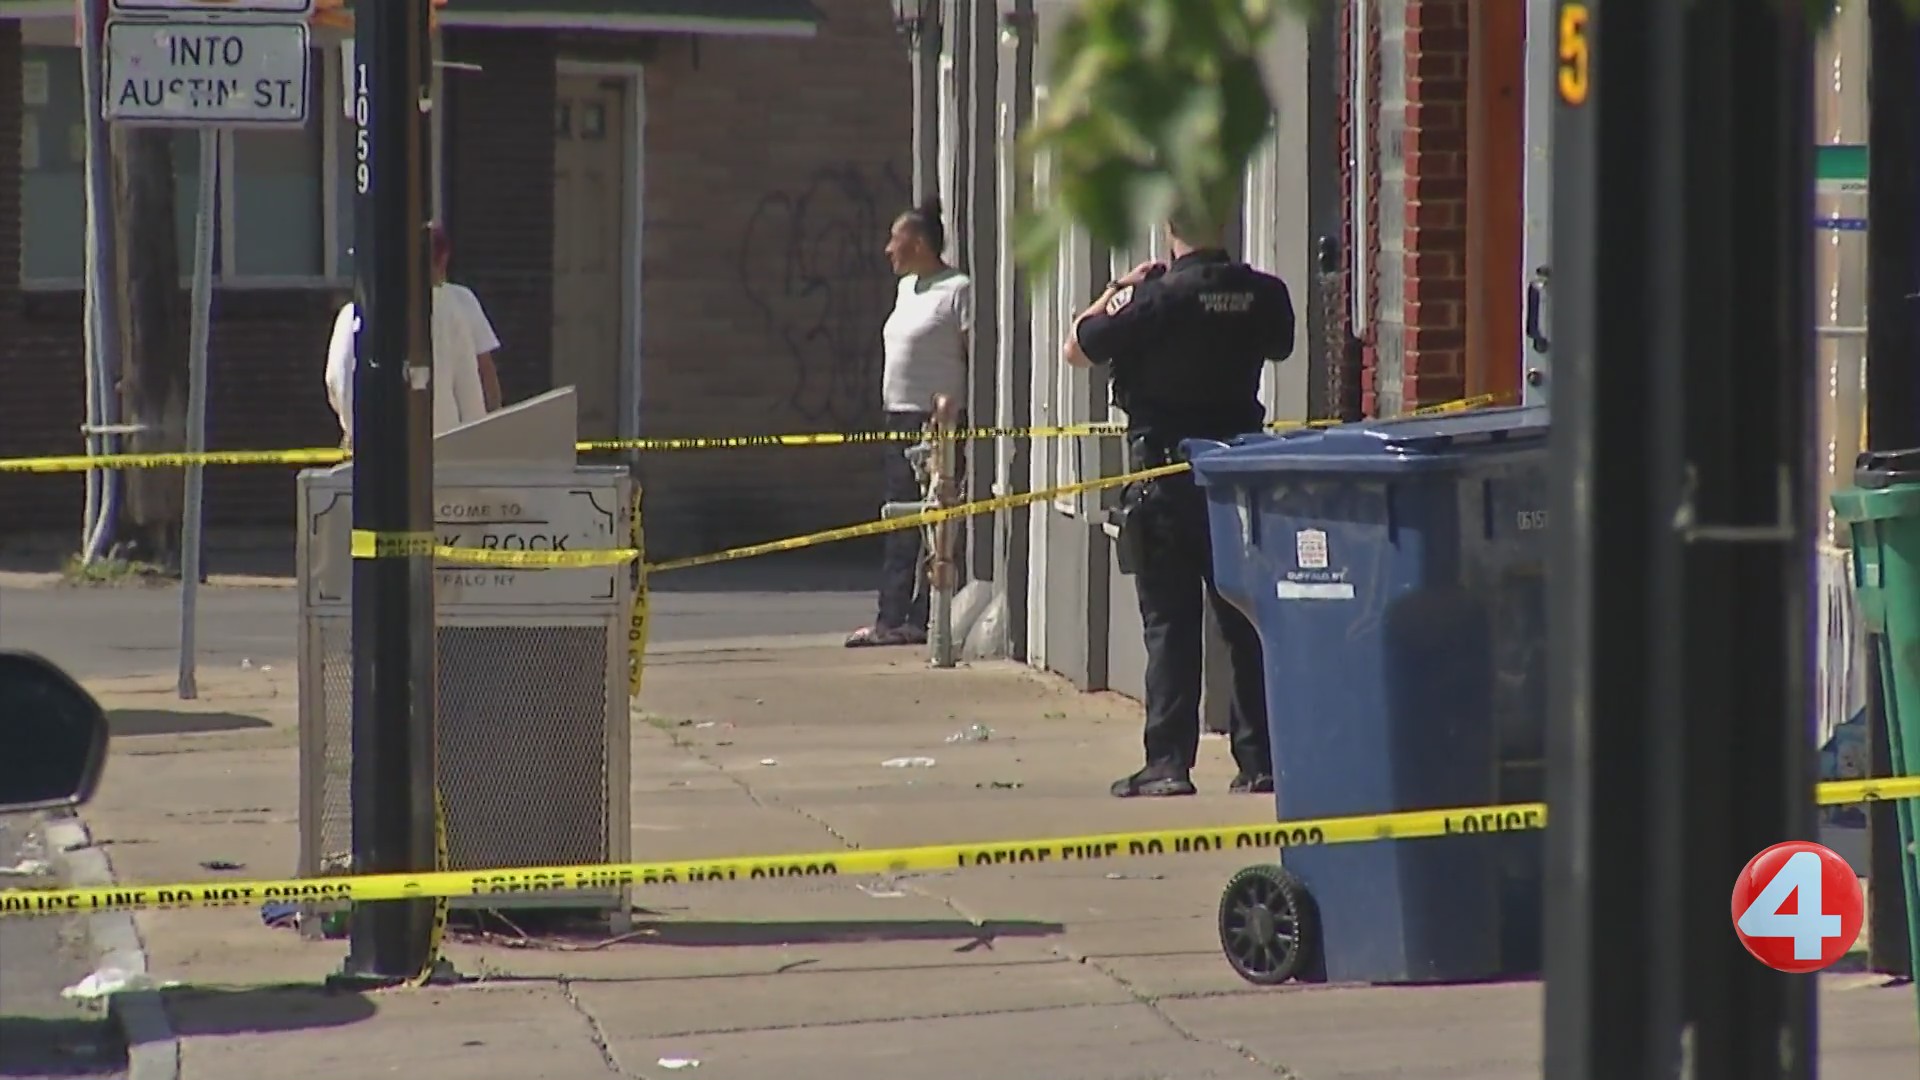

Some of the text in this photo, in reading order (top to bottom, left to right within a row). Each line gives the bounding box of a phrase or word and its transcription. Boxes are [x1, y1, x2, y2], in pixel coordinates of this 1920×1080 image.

[170, 35, 243, 66] INTO
[1559, 3, 1589, 105] 5
[254, 78, 295, 108] ST.
[357, 63, 369, 194] 1059
[440, 503, 521, 517] COME TO
[442, 574, 486, 587] FALO
[0, 894, 80, 913] OLICE
